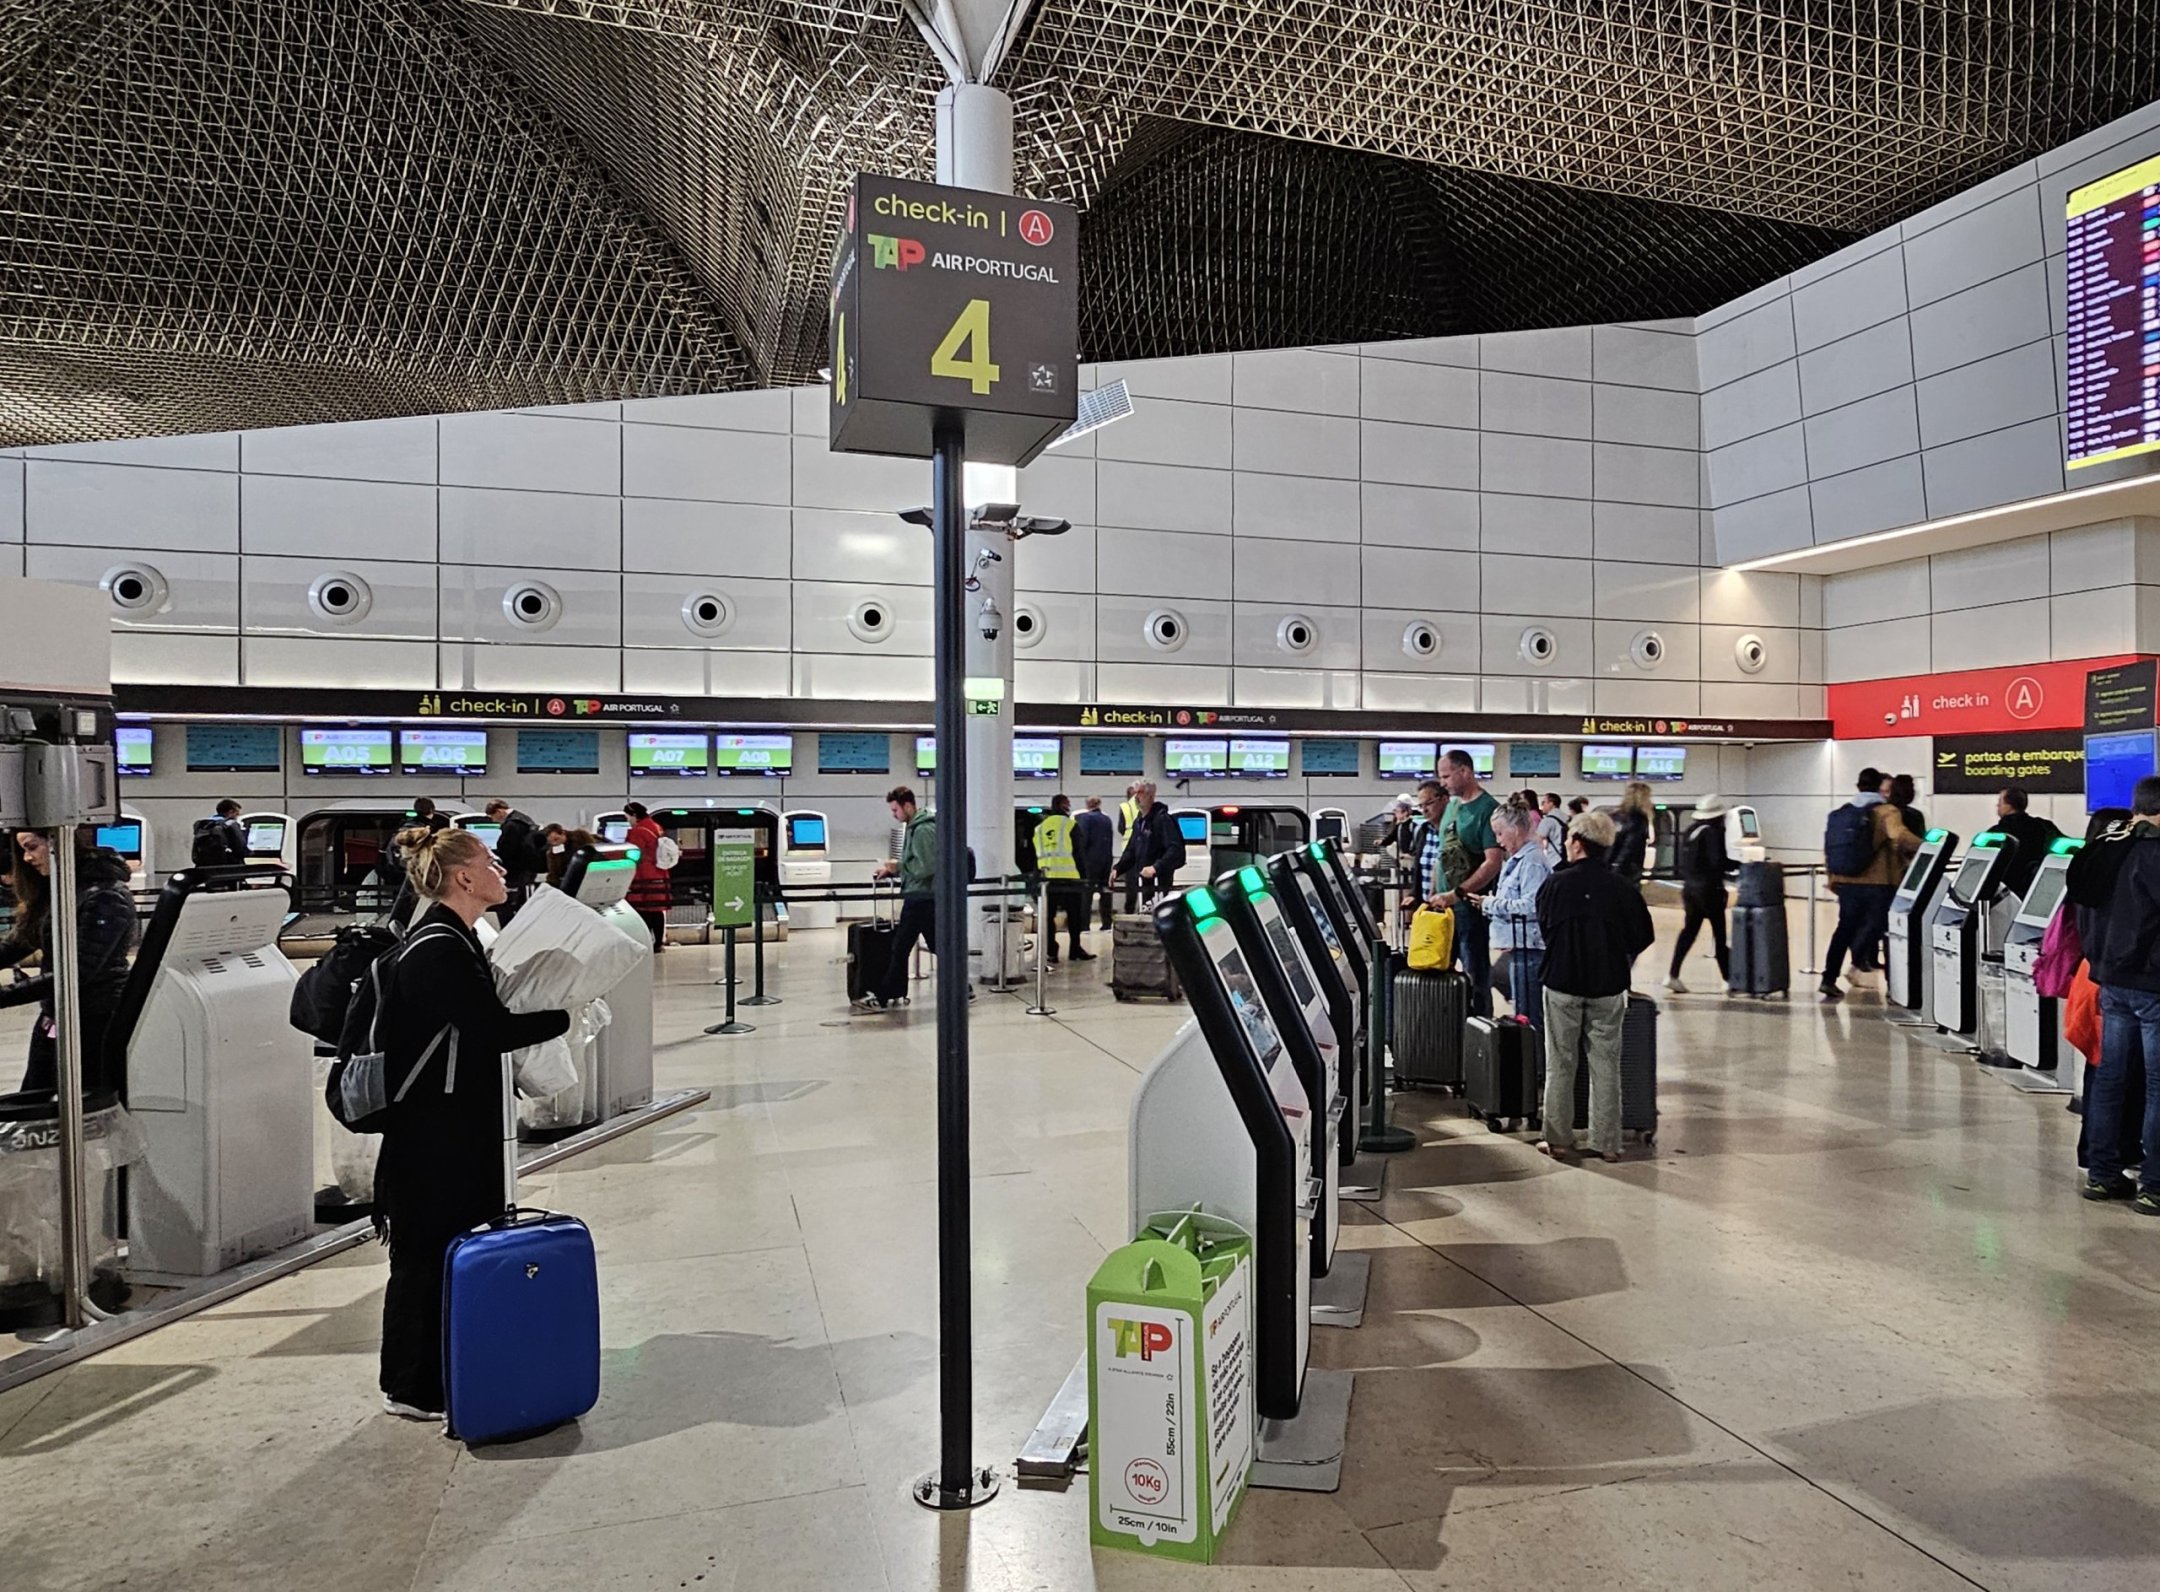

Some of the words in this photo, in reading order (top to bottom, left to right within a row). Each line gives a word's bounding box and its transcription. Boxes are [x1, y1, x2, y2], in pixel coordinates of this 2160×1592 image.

[874, 193, 989, 230] check-in
[867, 233, 926, 272] TAP
[931, 299, 1000, 395] 4
[1932, 693, 1973, 709] check
[1976, 692, 1989, 706] in
[2015, 684, 2034, 710] A
[450, 698, 528, 713] check-in
[573, 699, 601, 715] TAP
[1104, 710, 1163, 724] check-in
[1600, 720, 1645, 733] check-in
[323, 745, 371, 762] A05
[420, 745, 467, 762] A06
[652, 750, 685, 763] A07
[1180, 753, 1212, 767] A11
[1243, 753, 1275, 767] A12
[1965, 752, 2003, 764] portas
[2005, 750, 2020, 761] de
[2022, 749, 2085, 763] embarque
[1965, 765, 2015, 778] boarding
[2017, 765, 2051, 778] gates
[1107, 1317, 1173, 1362] TAP
[1166, 1393, 1175, 1416] 22in
[1166, 1427, 1176, 1456] 55cm
[1132, 1473, 1161, 1492] 10Kg
[1118, 1516, 1145, 1529] 25cm
[1156, 1522, 1177, 1534] 10in
